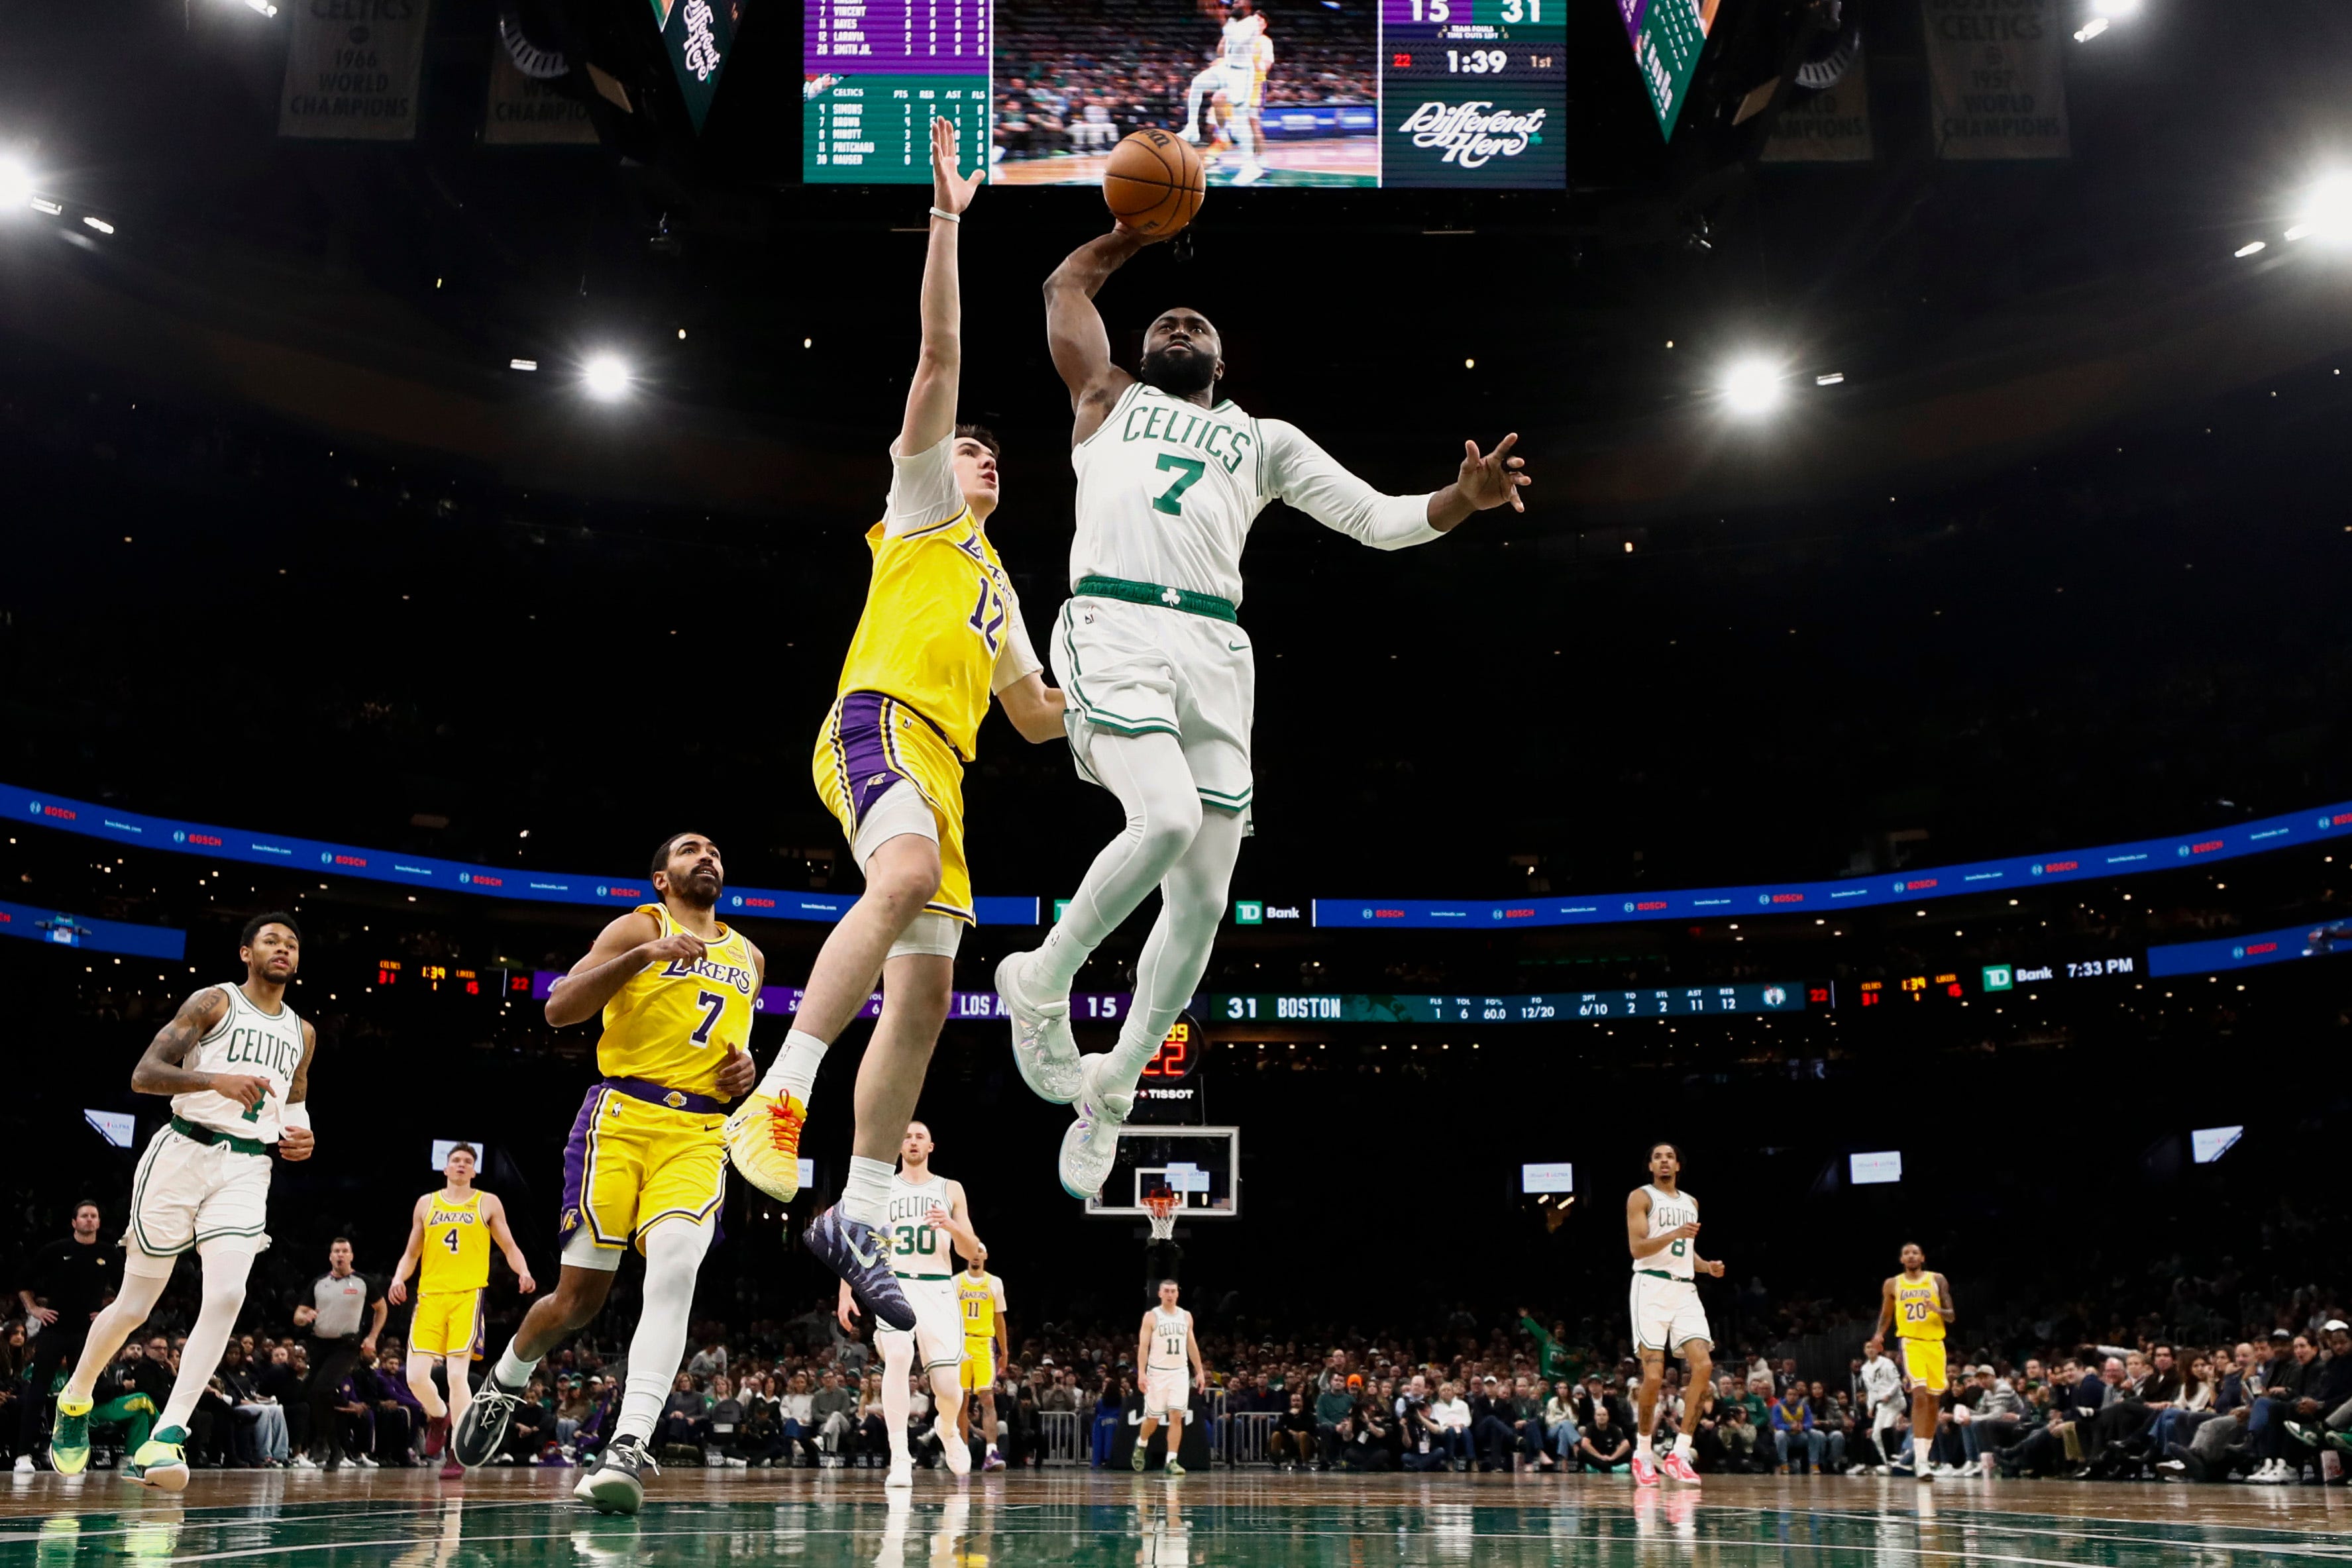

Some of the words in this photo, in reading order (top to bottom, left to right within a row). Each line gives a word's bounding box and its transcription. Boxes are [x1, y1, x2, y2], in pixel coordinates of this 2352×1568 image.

[820, 6, 826, 16] 7
[833, 6, 867, 17] VINCENT
[1409, 0, 1450, 23] 15
[1500, 0, 1540, 23] 31
[820, 19, 826, 28] 11
[833, 19, 857, 29] HAYES
[818, 31, 827, 42] 12
[833, 32, 865, 42] LARAVIA
[817, 44, 828, 55] 20
[833, 44, 857, 55] SMITH
[859, 44, 872, 55] JR.
[1393, 54, 1412, 67] 22
[1447, 50, 1507, 73] 1:39
[1531, 56, 1552, 68] 1st
[319, 74, 388, 91] WORLD
[920, 90, 934, 99] REB
[972, 91, 985, 99] FLS
[291, 97, 407, 117] CHAMPIONS
[819, 104, 825, 114] 4
[833, 104, 863, 115] SIMONS
[820, 117, 825, 127] 7
[833, 117, 860, 127] BROWN
[1399, 101, 1546, 132] Different
[833, 129, 862, 139] MINOTT
[819, 142, 826, 152] 11
[833, 142, 875, 153] PRITCHARD
[1413, 124, 1528, 168] Here
[817, 154, 828, 164] 30
[833, 154, 863, 164] HAUSER
[1123, 406, 1251, 474] CELTICS
[1153, 453, 1205, 516] 7
[969, 576, 1004, 653] 12
[45, 806, 76, 819] BOSCH
[189, 834, 222, 845] BOSCH
[2192, 841, 2223, 853] BOSCH
[336, 856, 366, 866] BOSCH
[2046, 862, 2078, 872] BOSCH
[473, 876, 502, 886] BOSCH
[1907, 880, 1937, 890] BOSCH
[611, 888, 640, 897] BOSCH
[746, 898, 775, 907] BOSCH
[1239, 905, 1260, 919] TD
[1267, 908, 1299, 917] Bank
[378, 970, 396, 984] 31
[423, 967, 445, 979] 1:39
[661, 959, 750, 994] LAKERS
[1986, 970, 2009, 986] TD
[2017, 967, 2052, 981] Bank
[2068, 961, 2102, 977] 7:33
[2108, 958, 2133, 973] PM
[466, 981, 478, 994] 15
[512, 977, 528, 990] 22
[1902, 977, 1926, 990] 1:39
[1811, 989, 1827, 1002] 22
[873, 1004, 880, 1014] 6
[961, 995, 990, 1016] LOS
[1088, 997, 1116, 1018] 15
[1228, 998, 1256, 1018] 31
[1279, 998, 1340, 1018] BOSTON
[1436, 1009, 1440, 1018] 1
[1461, 1009, 1468, 1018] 6
[1484, 1009, 1506, 1019] 60.0
[1523, 1006, 1554, 1018] 12/20
[1580, 1004, 1607, 1015] 6/10
[1629, 1003, 1635, 1013] 2
[1660, 1002, 1667, 1012] 2
[1691, 1000, 1703, 1010] 11
[1723, 998, 1735, 1009] 12
[691, 990, 725, 1043] 7
[227, 1028, 298, 1081] CELTICS
[1148, 1089, 1193, 1098] TISSOT
[429, 1211, 475, 1227] LAKERS
[444, 1228, 458, 1253] 4
[895, 1225, 936, 1255] 30
[1671, 1238, 1686, 1257] 8
[959, 1290, 988, 1300] LAKERS
[1900, 1289, 1931, 1301] LAKERS
[968, 1302, 979, 1318] 11
[1905, 1302, 1926, 1320] 20
[1159, 1322, 1186, 1337] CELTICS
[1166, 1339, 1179, 1355] 11
